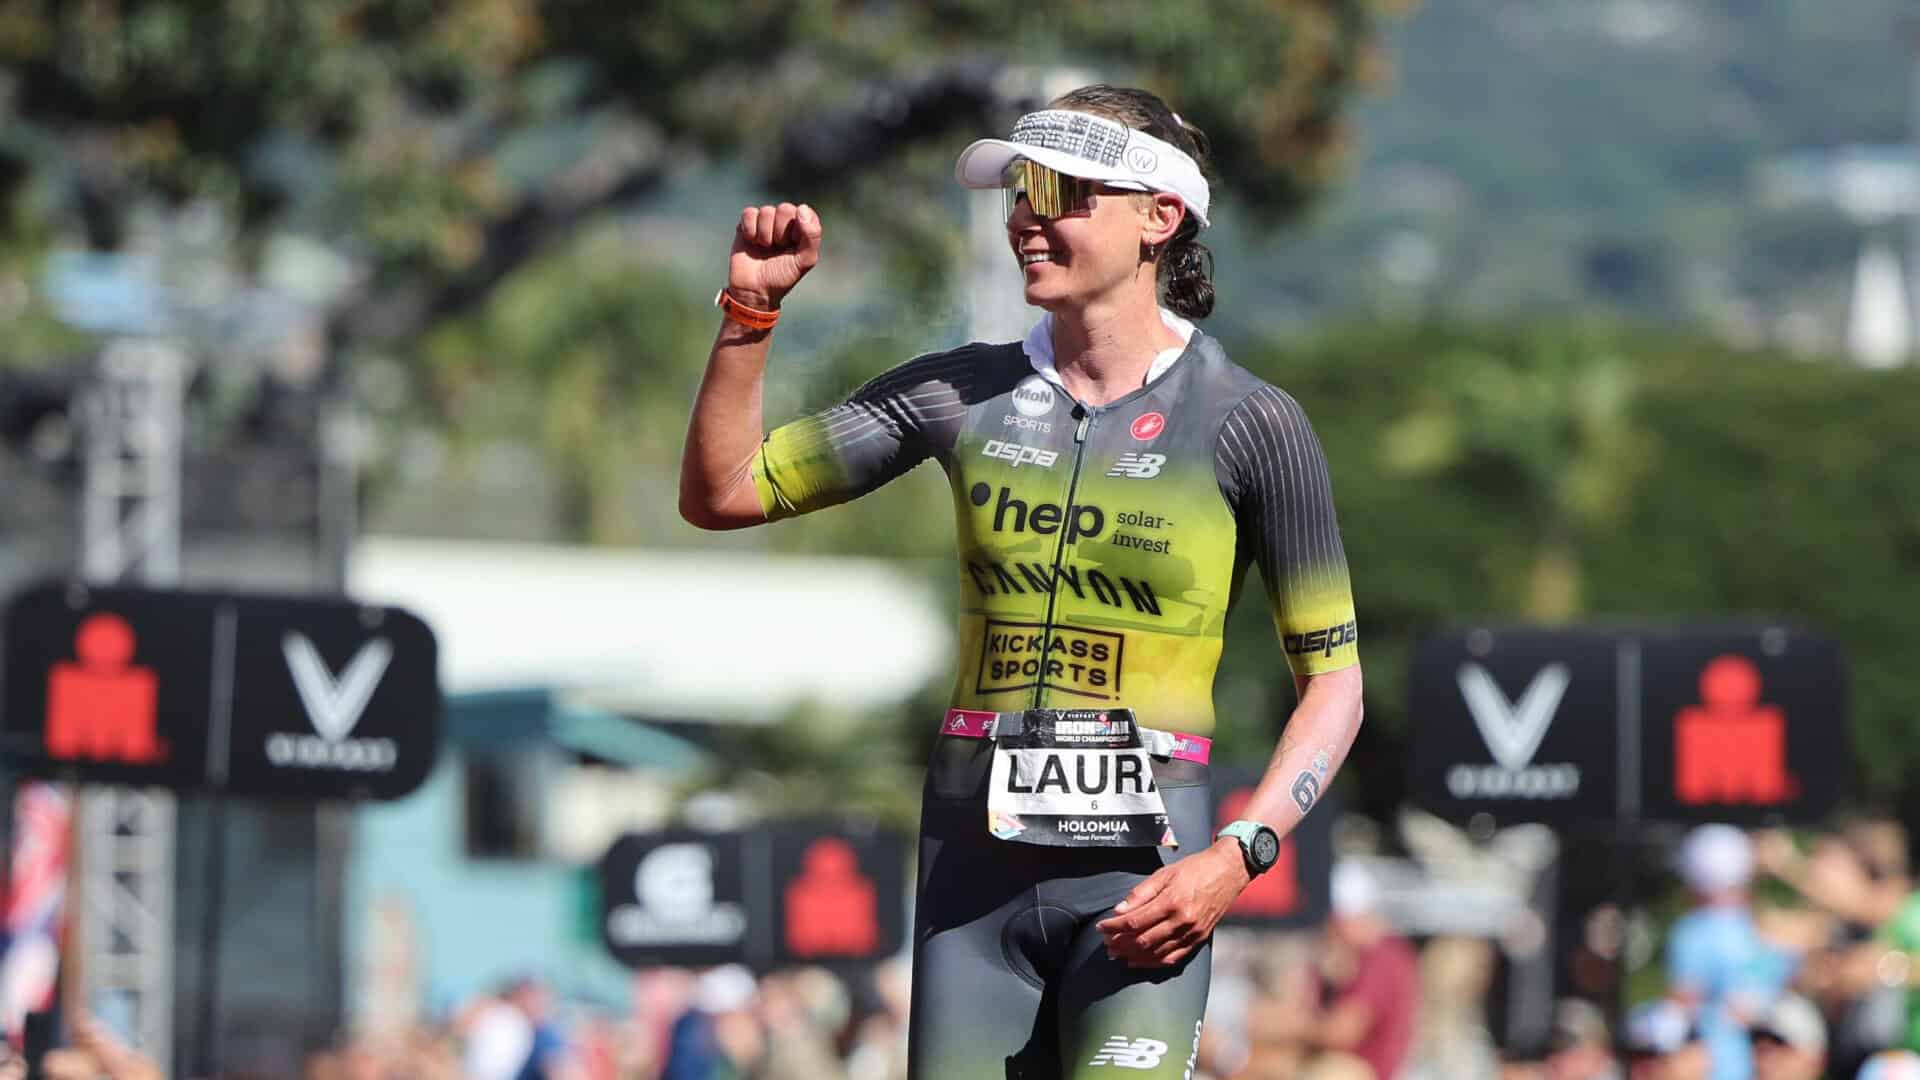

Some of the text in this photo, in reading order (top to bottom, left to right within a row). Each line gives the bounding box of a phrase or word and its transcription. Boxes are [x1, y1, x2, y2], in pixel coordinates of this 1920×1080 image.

[1003, 415, 1051, 433] SPORTS
[1111, 530, 1171, 554] invest
[967, 561, 1162, 617] CANYON
[990, 660, 1108, 687] SPORTS
[1090, 800, 1099, 811] 6
[1058, 820, 1130, 833] HOLOMUA
